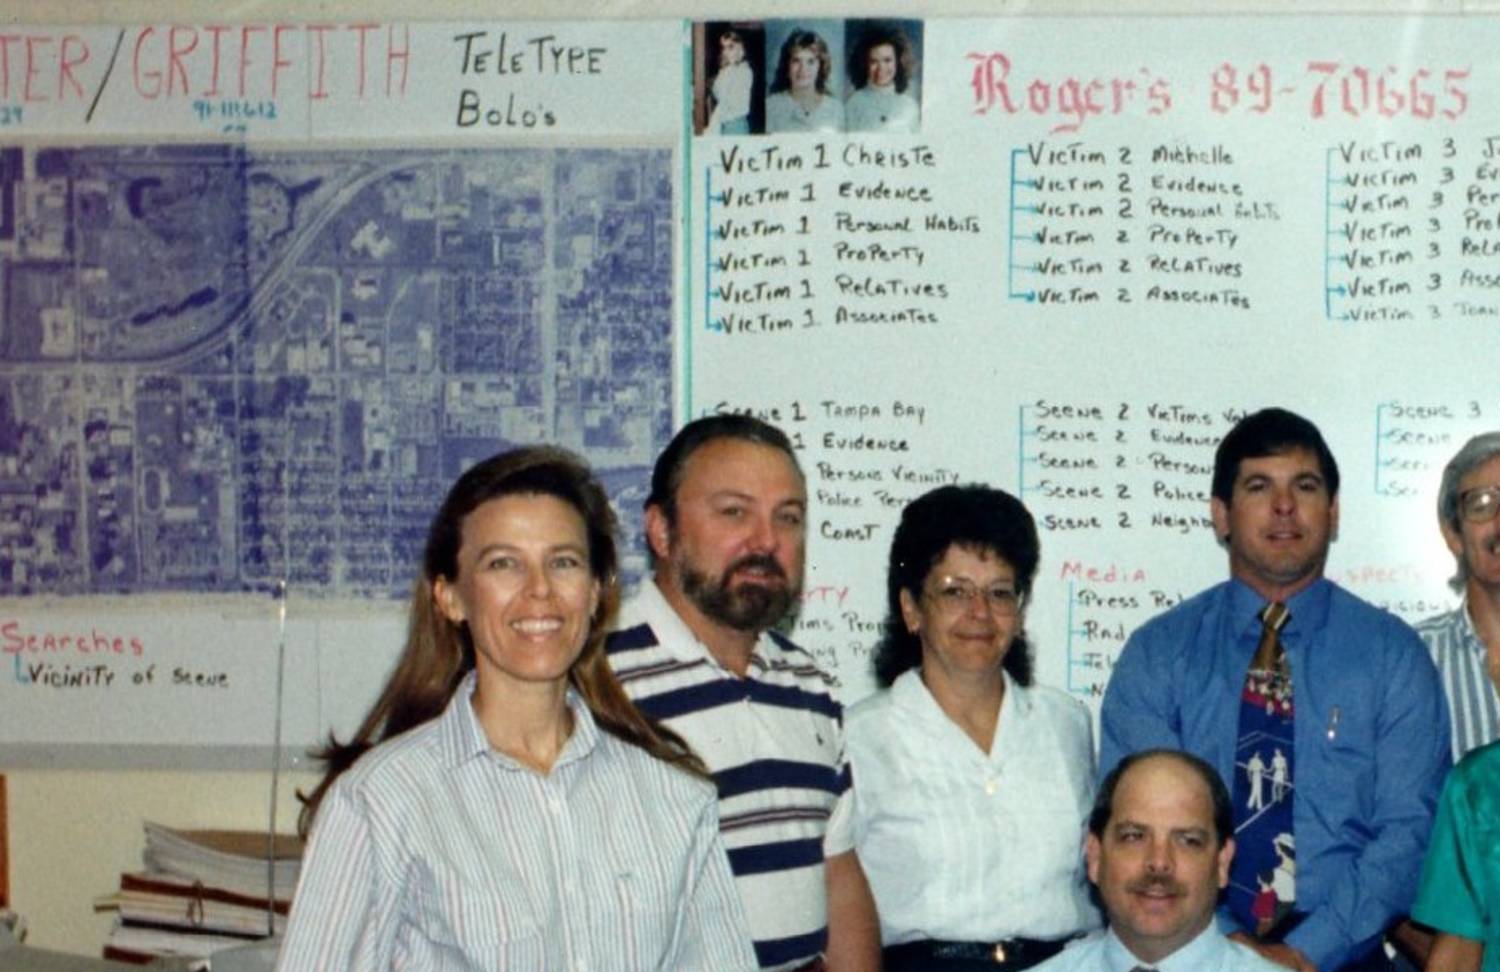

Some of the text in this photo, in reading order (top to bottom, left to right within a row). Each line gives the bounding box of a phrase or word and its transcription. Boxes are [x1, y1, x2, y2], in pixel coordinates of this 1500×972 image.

[965, 51, 1472, 136] Roger's 89-70665
[814, 144, 830, 170] 1
[1119, 147, 1133, 165] 2
[1151, 145, 1234, 165] Michelle
[1442, 137, 1457, 159] 3
[1118, 173, 1133, 193] 2
[1151, 175, 1244, 196] Evidence
[1440, 168, 1455, 184] 3
[800, 183, 816, 202] 1
[839, 182, 932, 202] Evidence
[1428, 192, 1444, 207] 3
[1118, 198, 1135, 219] 2
[1149, 198, 1222, 220] Personal
[797, 215, 811, 235] 1
[836, 212, 912, 233] Personal
[1428, 218, 1441, 233] 3
[1117, 230, 1129, 243] 2
[798, 250, 811, 267] 1
[1427, 243, 1441, 259] 3
[1119, 259, 1131, 273] 2
[1148, 256, 1242, 278] Relatives
[800, 280, 815, 298] 1
[836, 273, 948, 298] Relatives
[1426, 274, 1441, 290] 3
[1118, 289, 1132, 302] 2
[1146, 286, 1250, 309] Associates
[802, 310, 818, 327] 1
[836, 306, 938, 324] Associates
[821, 400, 881, 418] Tampa
[892, 402, 926, 426] Bay
[1117, 403, 1129, 420] 2
[823, 432, 909, 451] Evidence
[1115, 431, 1128, 443] 2
[1116, 455, 1125, 468] 2
[1117, 485, 1131, 499] 2
[1118, 512, 1132, 529] 2
[1061, 561, 1146, 582] Media
[1078, 589, 1139, 608] Press
[0, 622, 144, 656] Searches
[132, 664, 156, 684] of
